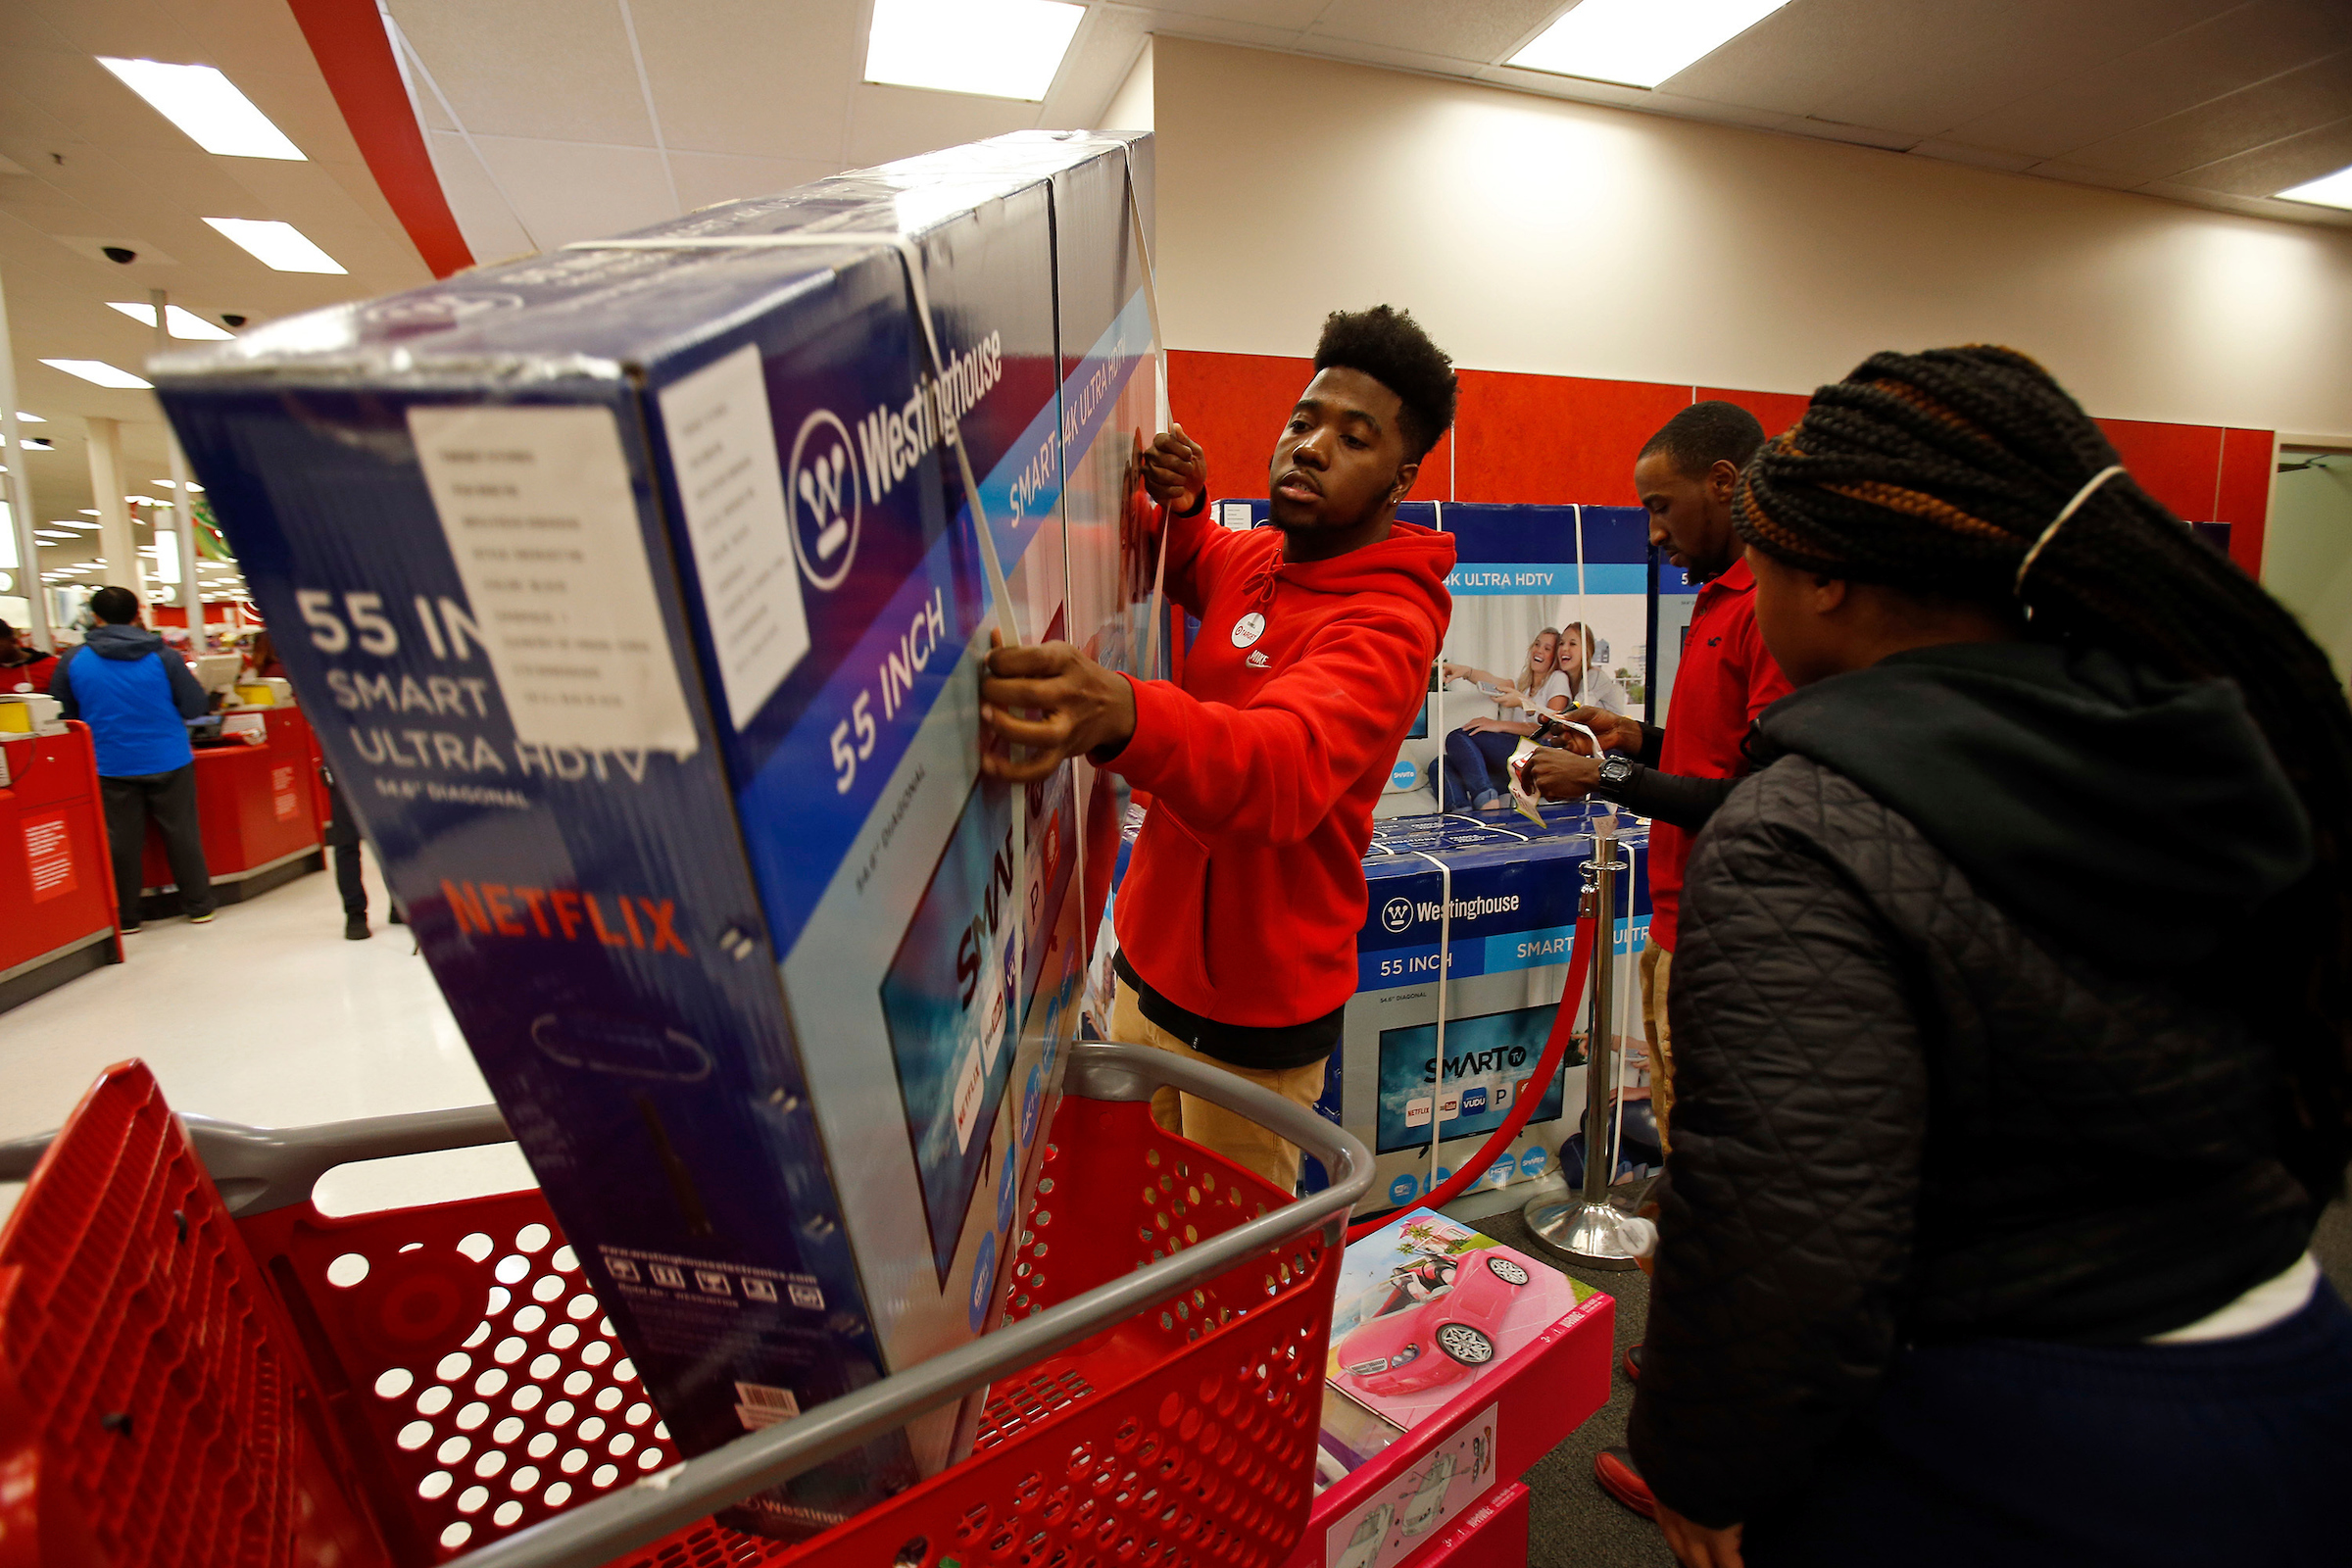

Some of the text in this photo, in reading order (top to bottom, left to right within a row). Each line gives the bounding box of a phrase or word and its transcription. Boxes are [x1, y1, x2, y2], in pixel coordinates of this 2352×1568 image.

[858, 329, 1002, 506] Westinghouse
[1009, 430, 1055, 528] SMART
[1080, 363, 1107, 426] ULTRA
[1108, 334, 1125, 384] HDTV
[1443, 572, 1553, 586] 4K ULTRA HDTV
[296, 589, 490, 660] 55 IN
[1250, 650, 1269, 665] NIKE
[326, 668, 490, 719] SMART
[829, 587, 946, 795] 55 INCH
[349, 727, 650, 784] ULTRA HDTV
[440, 878, 693, 958] NETFLIX
[1417, 895, 1519, 923] Wetinghouse
[1517, 926, 1649, 958] SMART ULTR
[1380, 959, 1403, 977] 55
[1396, 992, 1428, 1002] DIAGONAL
[1424, 1046, 1508, 1083] SMART
[957, 1060, 981, 1130] NETFLIX
[1407, 1106, 1430, 1117] NETFLIX
[1463, 1098, 1486, 1108] VUDU
